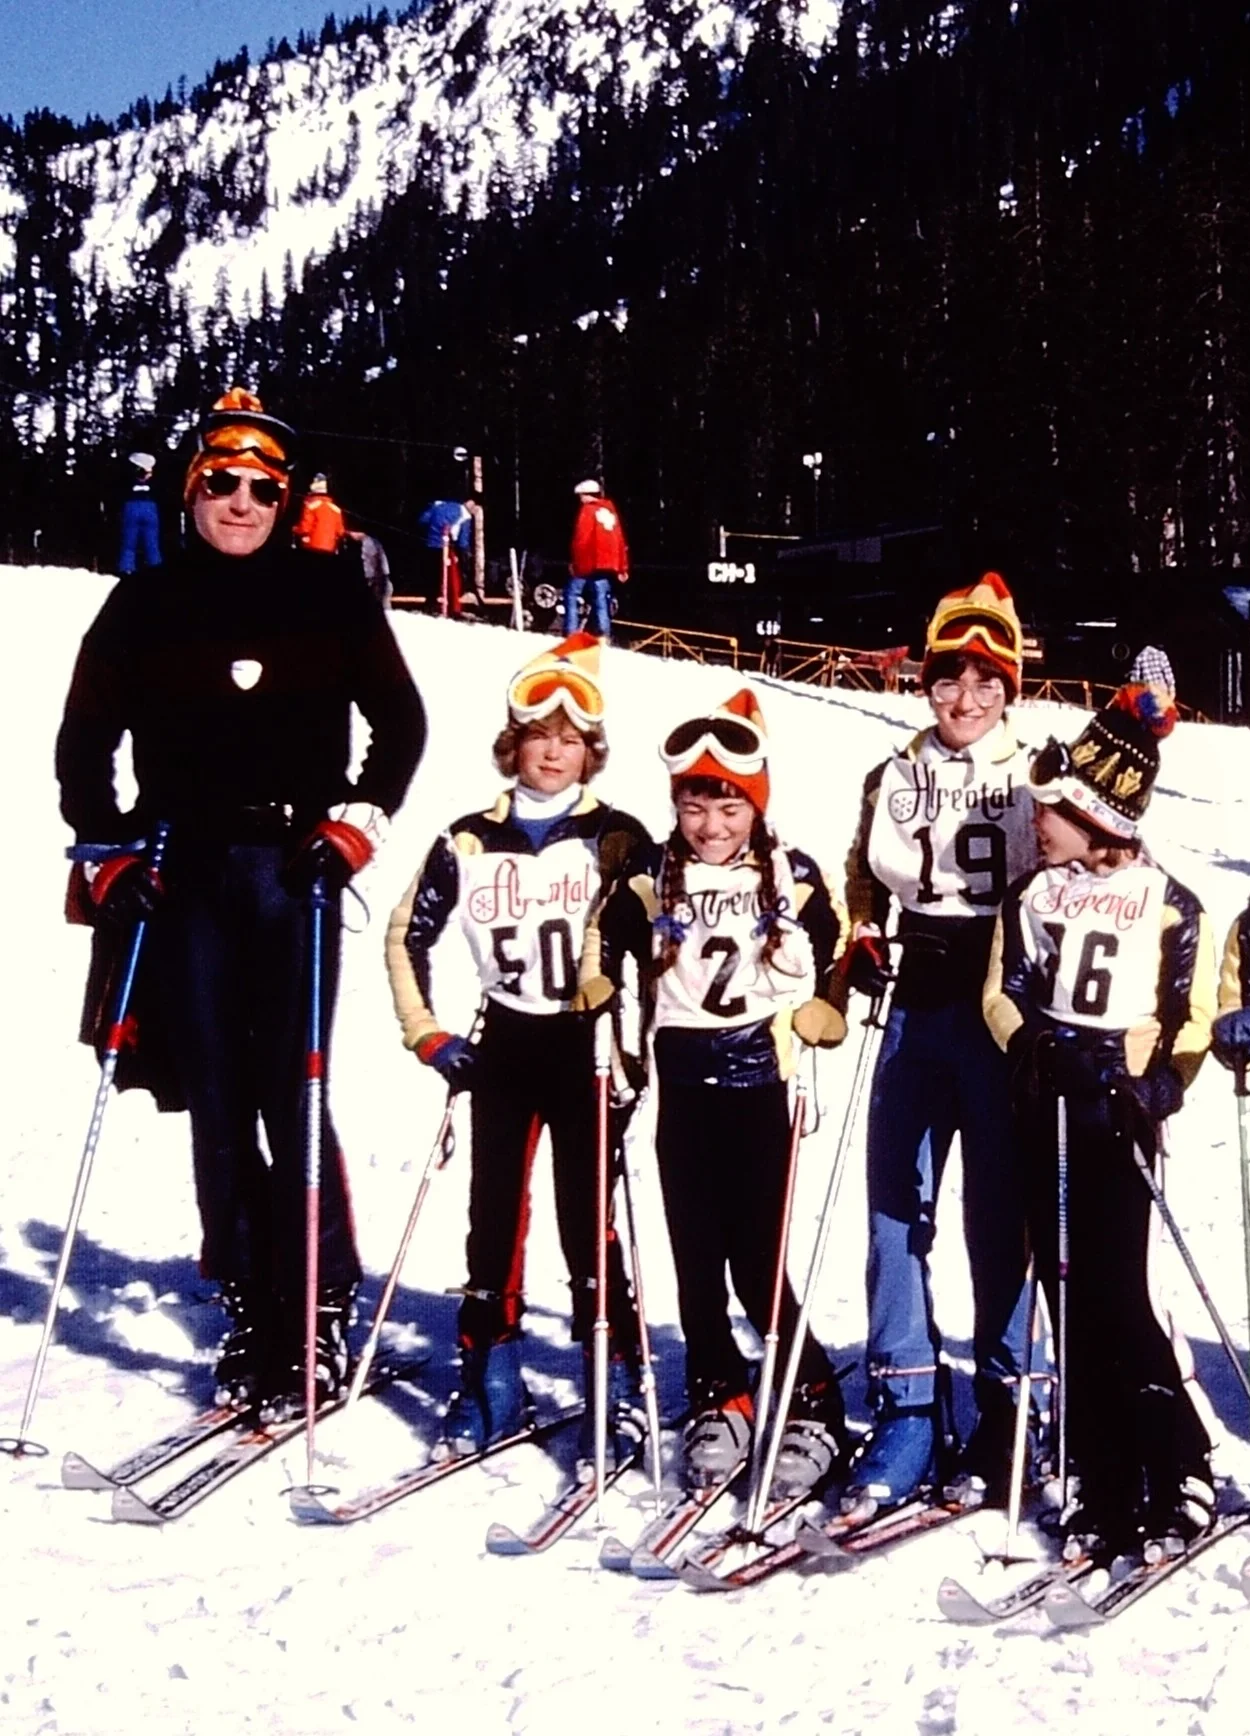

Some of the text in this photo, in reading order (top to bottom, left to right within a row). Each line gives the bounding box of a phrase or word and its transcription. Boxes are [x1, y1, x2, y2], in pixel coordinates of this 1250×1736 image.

[469, 859, 591, 924] Alntal
[912, 823, 1007, 906] 19
[490, 918, 578, 1001] 50
[701, 936, 747, 1018] 2
